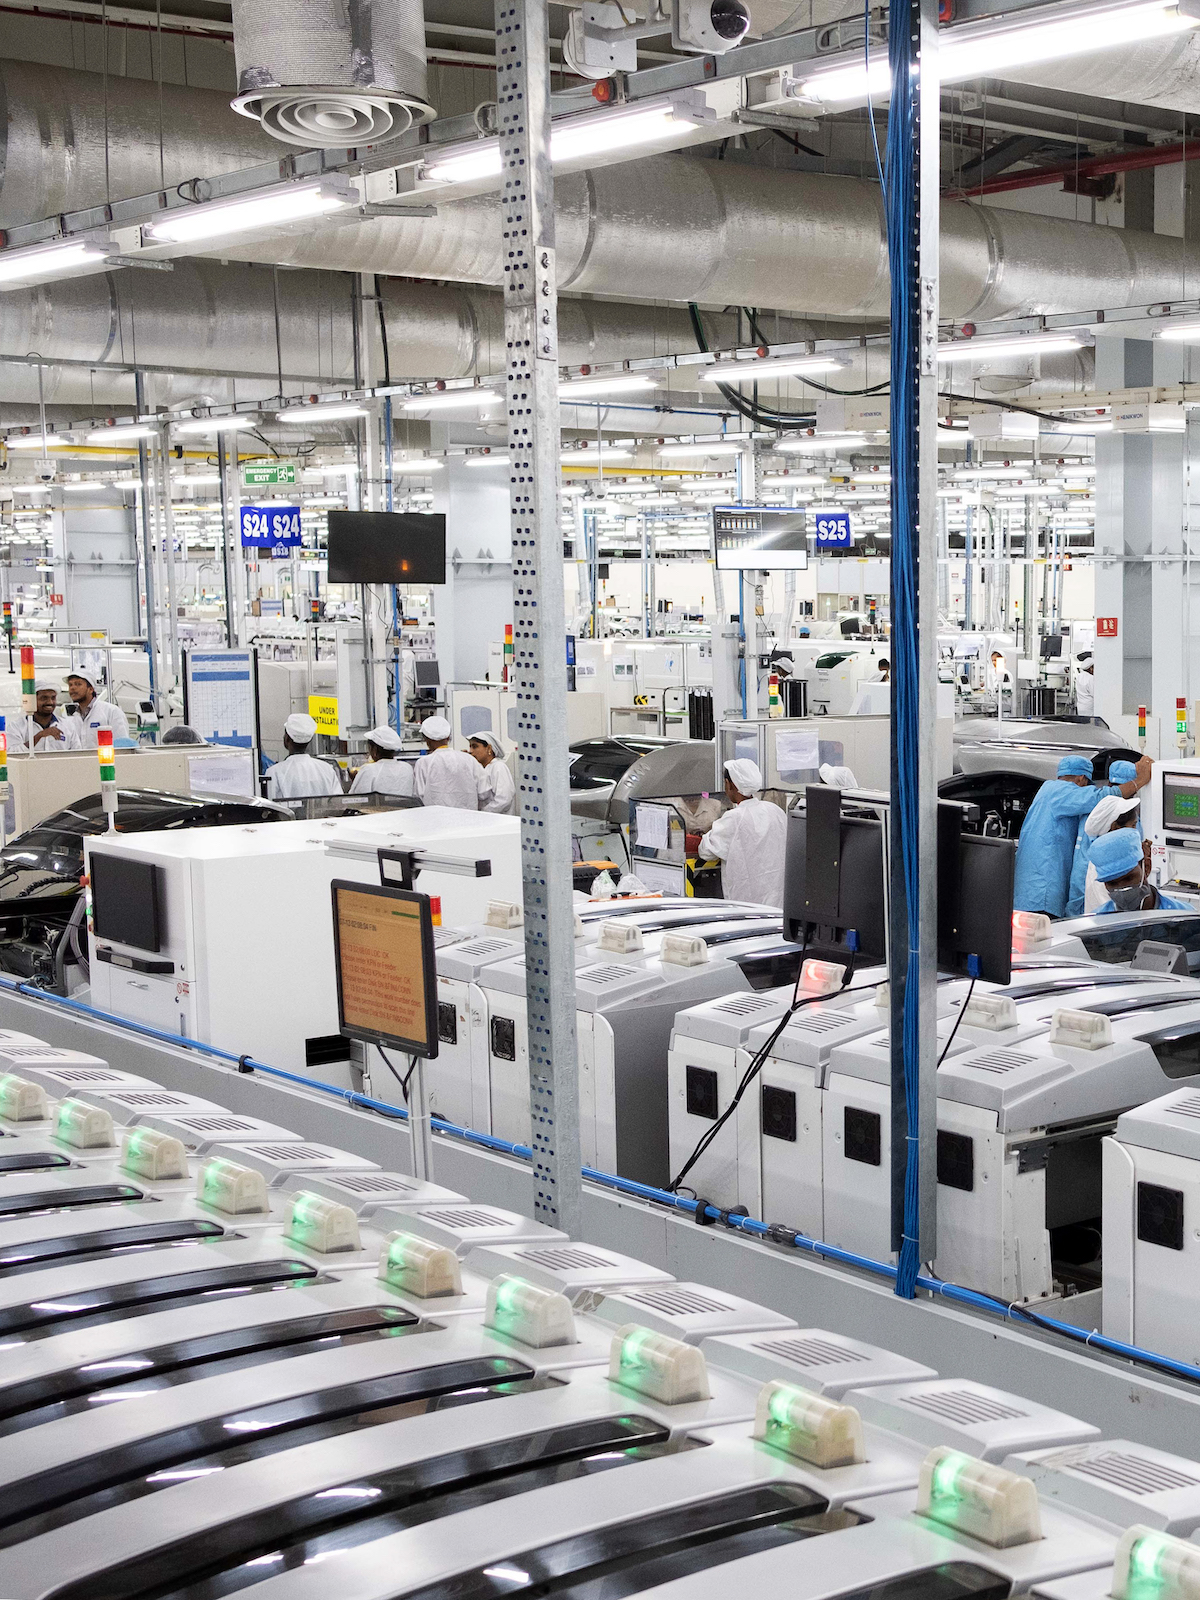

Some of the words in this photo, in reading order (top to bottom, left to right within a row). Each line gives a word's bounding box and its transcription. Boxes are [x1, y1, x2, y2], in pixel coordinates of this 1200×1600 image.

[243, 514, 268, 538] S24
[273, 514, 299, 538] S24
[818, 520, 847, 540] S25
[319, 707, 335, 715] UNDER
[312, 716, 339, 725] NSTALLATI
